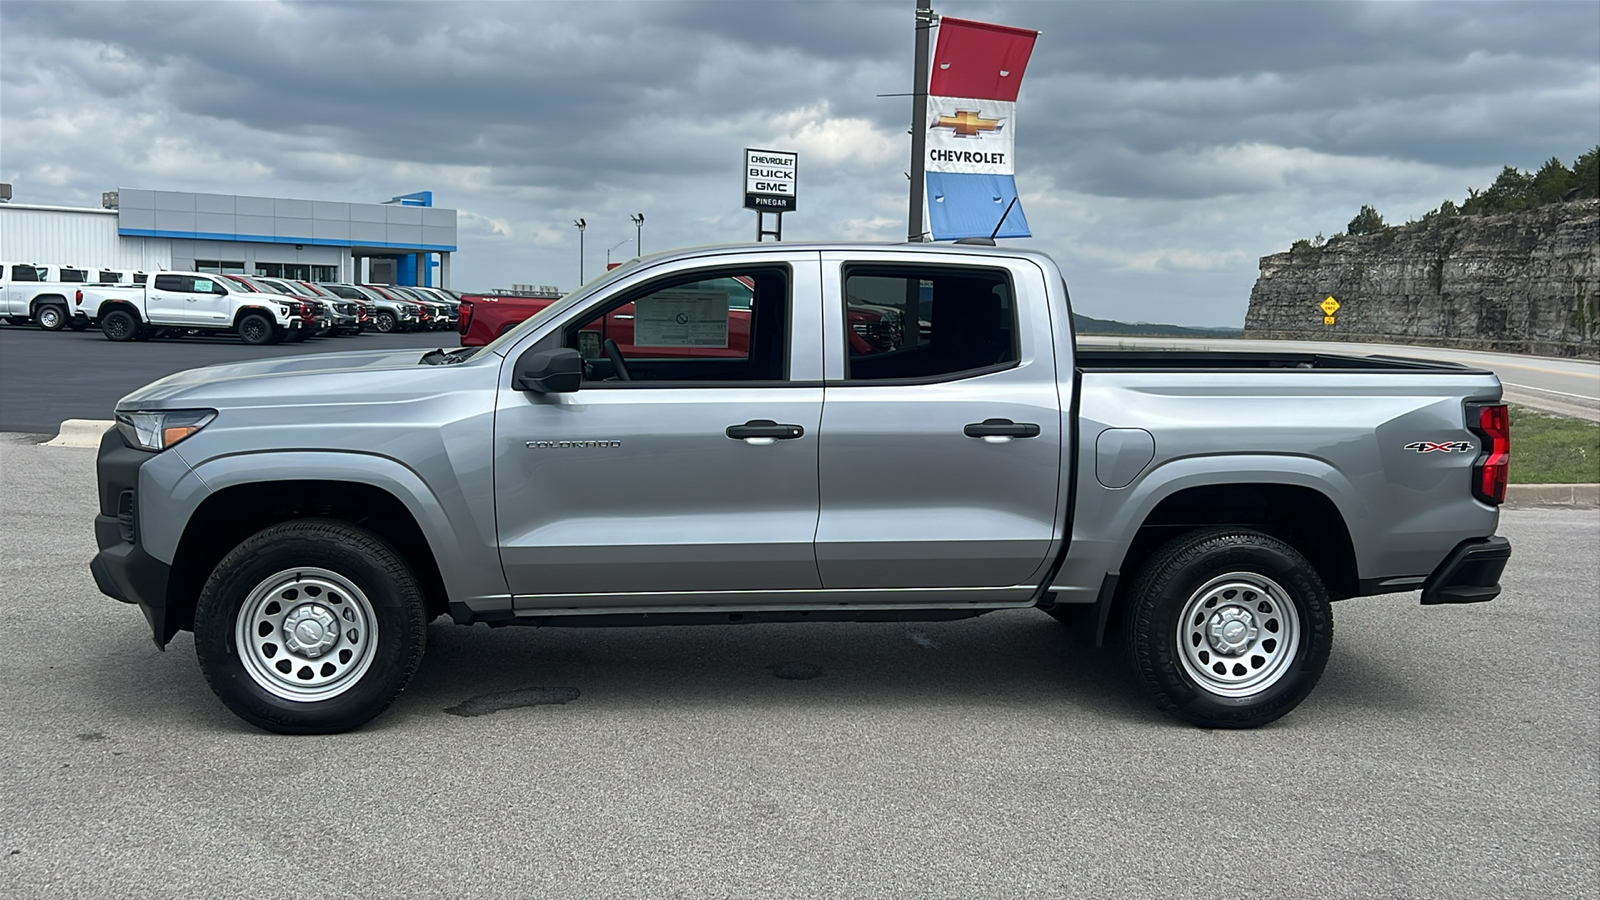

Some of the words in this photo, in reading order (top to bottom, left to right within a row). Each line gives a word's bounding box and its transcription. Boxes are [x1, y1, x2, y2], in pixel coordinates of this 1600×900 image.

[751, 156, 793, 166] CHEVROLET
[930, 149, 1005, 164] CHEVROLET
[750, 168, 793, 179] BUICK
[755, 182, 788, 192] GMC
[755, 197, 787, 206] PINEGAR
[525, 440, 621, 448] COLORADO
